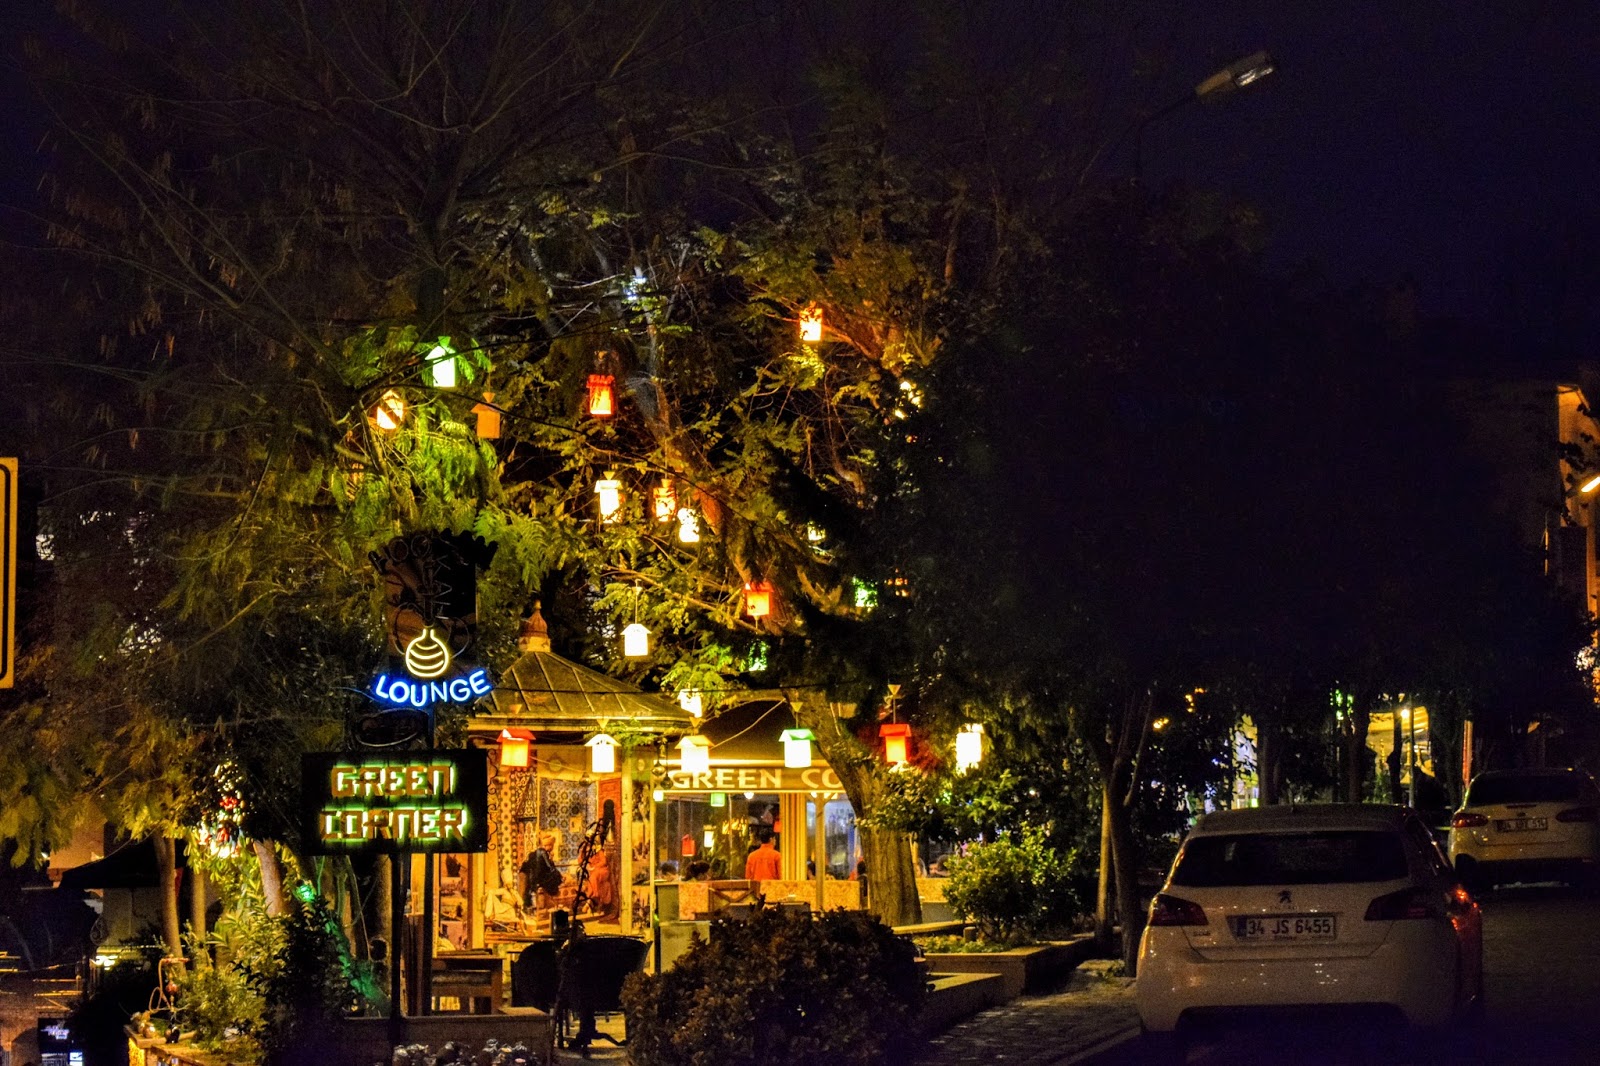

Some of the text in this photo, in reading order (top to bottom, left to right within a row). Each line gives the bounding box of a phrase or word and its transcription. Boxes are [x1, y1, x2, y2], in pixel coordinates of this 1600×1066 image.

[375, 670, 491, 707] LOUNGE
[331, 765, 453, 797] GREEN
[668, 768, 782, 789] GREEN
[319, 808, 467, 840] CORNER
[1248, 918, 1332, 935] 34 JS 6455
